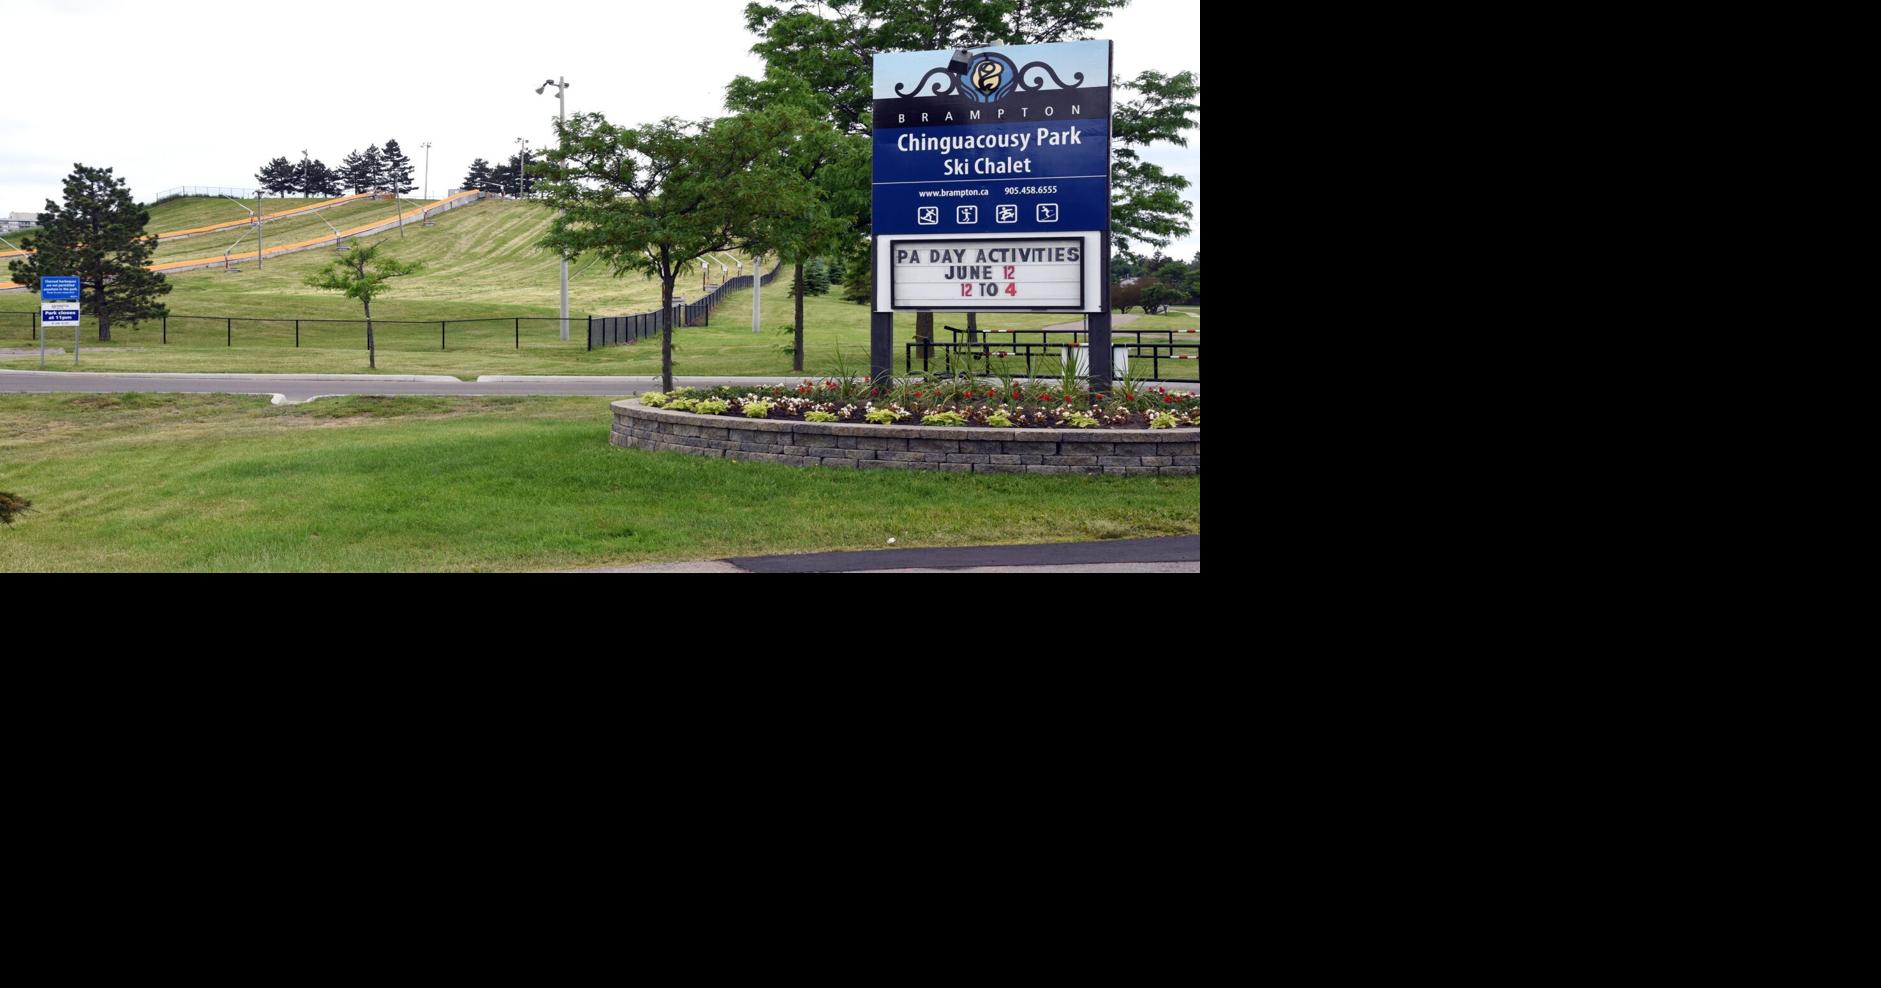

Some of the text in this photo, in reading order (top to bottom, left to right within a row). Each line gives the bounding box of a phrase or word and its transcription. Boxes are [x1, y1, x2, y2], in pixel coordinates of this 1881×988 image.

[899, 105, 1081, 123] BRAMPTON
[897, 126, 1081, 154] Chinguacousy Park
[943, 157, 1031, 176] Ski Chalet
[918, 185, 1057, 199] www.brampton.ca 905.458.6555
[898, 247, 1080, 264] PA DAY ACTIVITIES
[944, 265, 1015, 280] JUNE 12
[960, 282, 1017, 297] 12 TO 4
